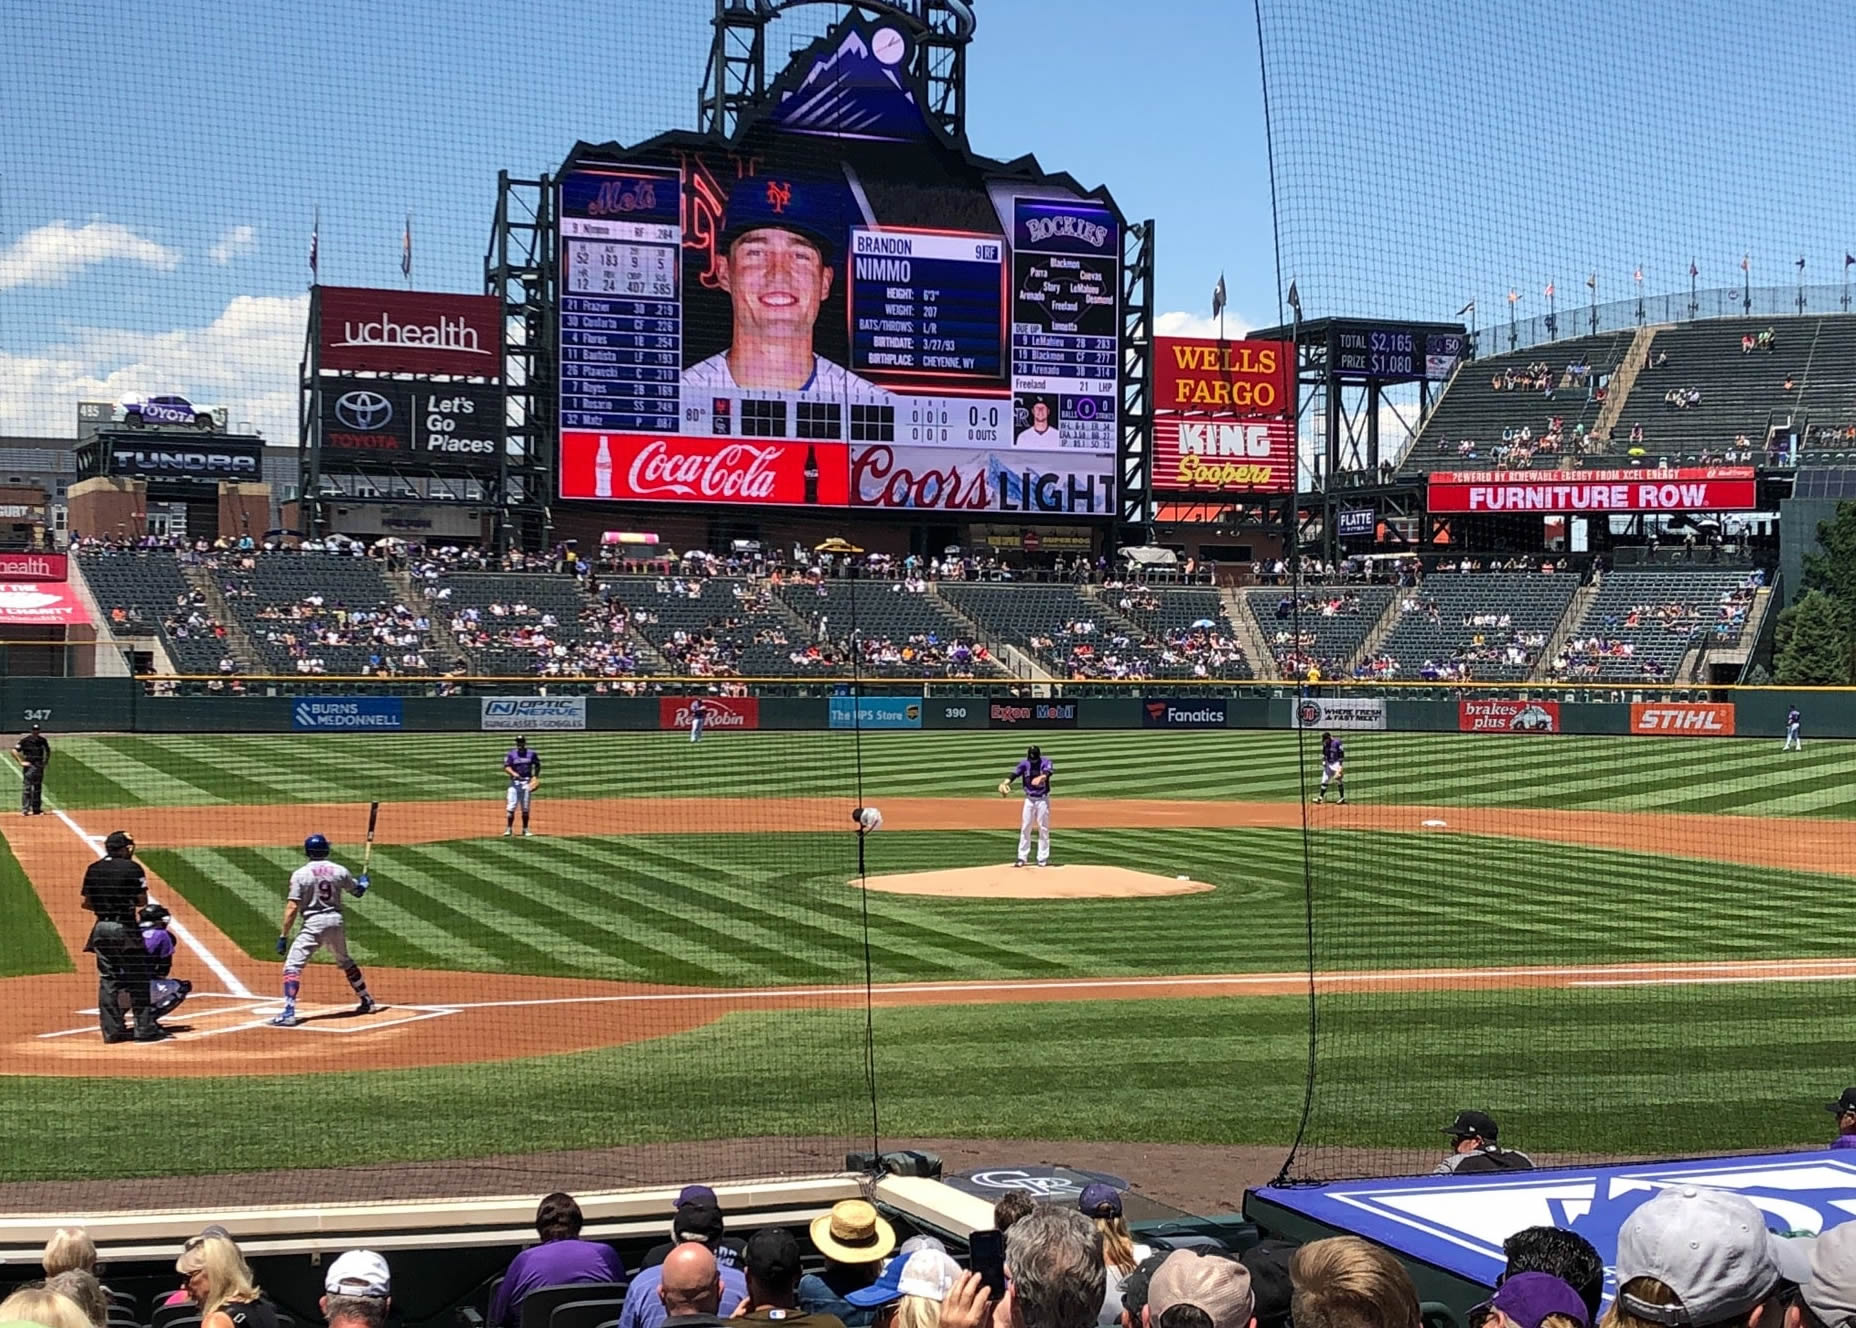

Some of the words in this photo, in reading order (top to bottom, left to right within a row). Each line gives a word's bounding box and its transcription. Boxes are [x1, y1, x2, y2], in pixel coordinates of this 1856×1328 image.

[588, 180, 656, 215] Mets
[1026, 216, 1108, 248] ROCKIES
[857, 236, 912, 256] BRANDON
[975, 245, 982, 260] 9
[984, 246, 995, 259] RF
[855, 257, 912, 284] NIMMO
[1050, 257, 1081, 270] Blackmon
[1030, 267, 1048, 278] Parra
[886, 286, 915, 300] HEIGHT:
[1043, 281, 1061, 294] Story
[885, 303, 915, 317] WEIGHT:
[923, 306, 938, 318] 207
[1052, 300, 1078, 312] Freeland
[345, 312, 478, 351] uchealth
[923, 322, 938, 334] L/R
[1015, 324, 1028, 334] DUE
[1030, 325, 1040, 335] UP
[873, 335, 915, 350] BIRTHDATE:
[923, 339, 956, 353] 3/27/93
[1031, 336, 1065, 348] LeMahieu
[1340, 333, 1367, 349] TOTAL
[1370, 331, 1413, 353] $2,165
[868, 351, 915, 367] BIRTHPLACE:
[962, 356, 975, 370] WY
[1031, 350, 1065, 362] Blackmon
[1172, 345, 1277, 374] WELLS
[1341, 354, 1366, 369] PRIZE
[1371, 353, 1413, 375] $1,080
[1031, 364, 1060, 376] Arenado
[1015, 379, 1046, 391] Freeland
[1080, 381, 1089, 393] 21
[1098, 382, 1113, 394] LHP
[1175, 379, 1275, 406] FARGO
[426, 395, 475, 414] Let's
[139, 403, 196, 423] TOYOTA
[912, 410, 919, 423] 0
[926, 411, 933, 424] 0
[941, 412, 948, 425] 0
[427, 413, 455, 432] Go
[329, 432, 400, 449] TOYOTA
[912, 427, 919, 441] 0
[926, 428, 933, 442] 0
[941, 429, 948, 442] 0
[968, 429, 974, 441] 0
[975, 430, 998, 442] OUTS
[1178, 423, 1271, 457] KING
[427, 434, 495, 453] Places
[113, 451, 257, 472] TUNDRA
[628, 441, 787, 498] Coca-Cola
[1175, 454, 1273, 484] Soopers
[850, 444, 992, 509] Coors
[999, 471, 1116, 514] LIGHT
[1452, 471, 1492, 483] POWERED
[1494, 471, 1506, 483] BY
[1508, 471, 1559, 482] RENEWABLE
[1561, 470, 1592, 482] ENERGY
[1595, 469, 1620, 481] FROM
[1622, 469, 1644, 480] XCEL
[1646, 468, 1680, 480] ENERGY
[1469, 485, 1630, 510] FURNITURE
[1637, 484, 1707, 508] ROW
[311, 703, 358, 714] BURNS
[515, 707, 583, 716] NERVE
[519, 700, 573, 708] OPTIC
[1464, 703, 1517, 715] brakes
[23, 709, 52, 721] 347
[317, 714, 401, 726] McDONNELL
[673, 707, 693, 727] Re
[703, 707, 744, 727] Robin
[831, 709, 850, 721] The
[876, 709, 903, 721] Store
[944, 708, 967, 718] 390
[991, 704, 1031, 723] Exxon
[1036, 704, 1074, 719] Mobil
[1167, 707, 1225, 723] Fanatics
[1638, 709, 1723, 730] STIHL
[1471, 715, 1506, 730] plus
[318, 879, 332, 901] 9
